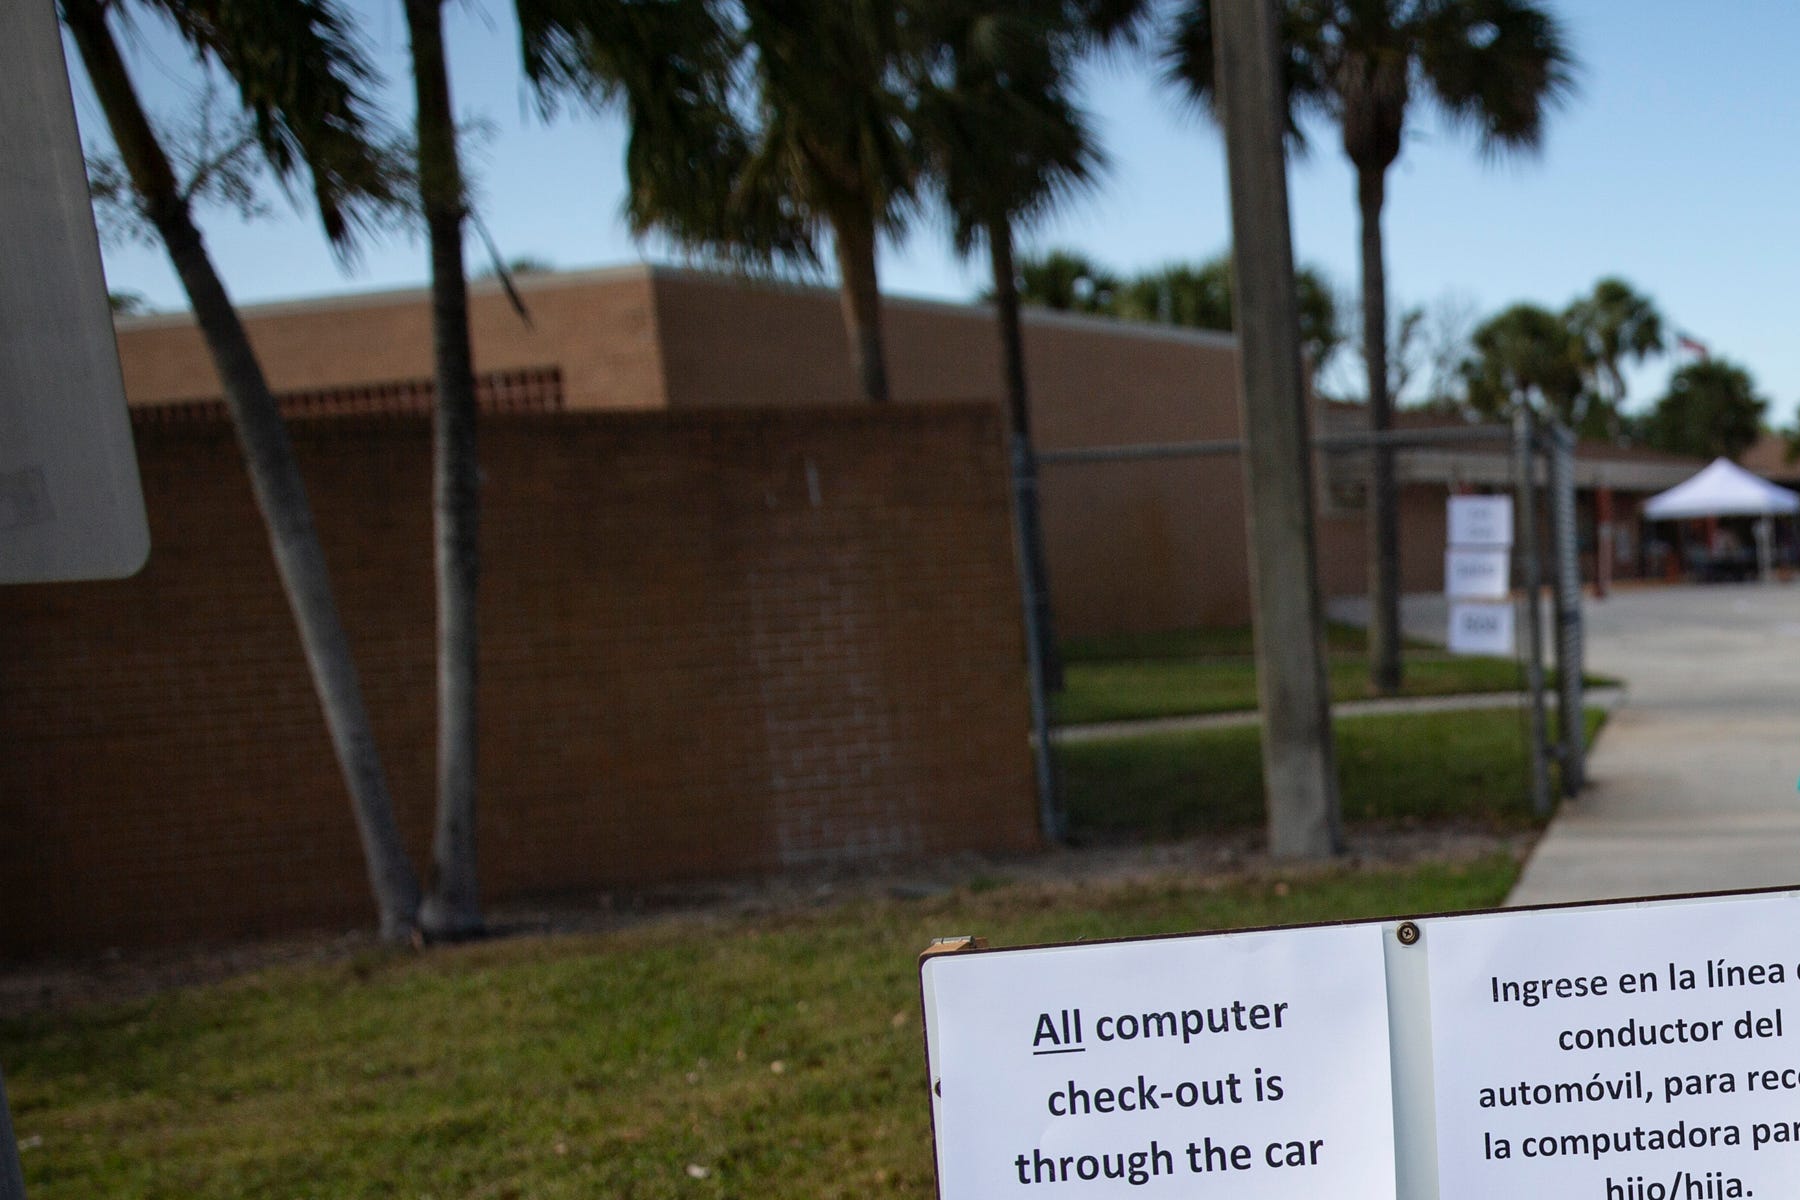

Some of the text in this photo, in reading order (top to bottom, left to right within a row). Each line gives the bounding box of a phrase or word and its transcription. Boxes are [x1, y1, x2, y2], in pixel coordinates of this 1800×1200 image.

[1490, 974, 1609, 1009] Ingrese
[1617, 971, 1659, 995] en
[1668, 961, 1697, 992] la
[1706, 957, 1786, 989] línea
[1031, 999, 1290, 1048] All computer
[1557, 1007, 1784, 1052] conductor del
[1047, 1066, 1285, 1118] check-out is
[1478, 1069, 1654, 1109] automóvil,
[1663, 1071, 1737, 1105] para
[1013, 1135, 1325, 1187] through the car
[1483, 1130, 1512, 1161] la
[1521, 1119, 1742, 1162] computadora
